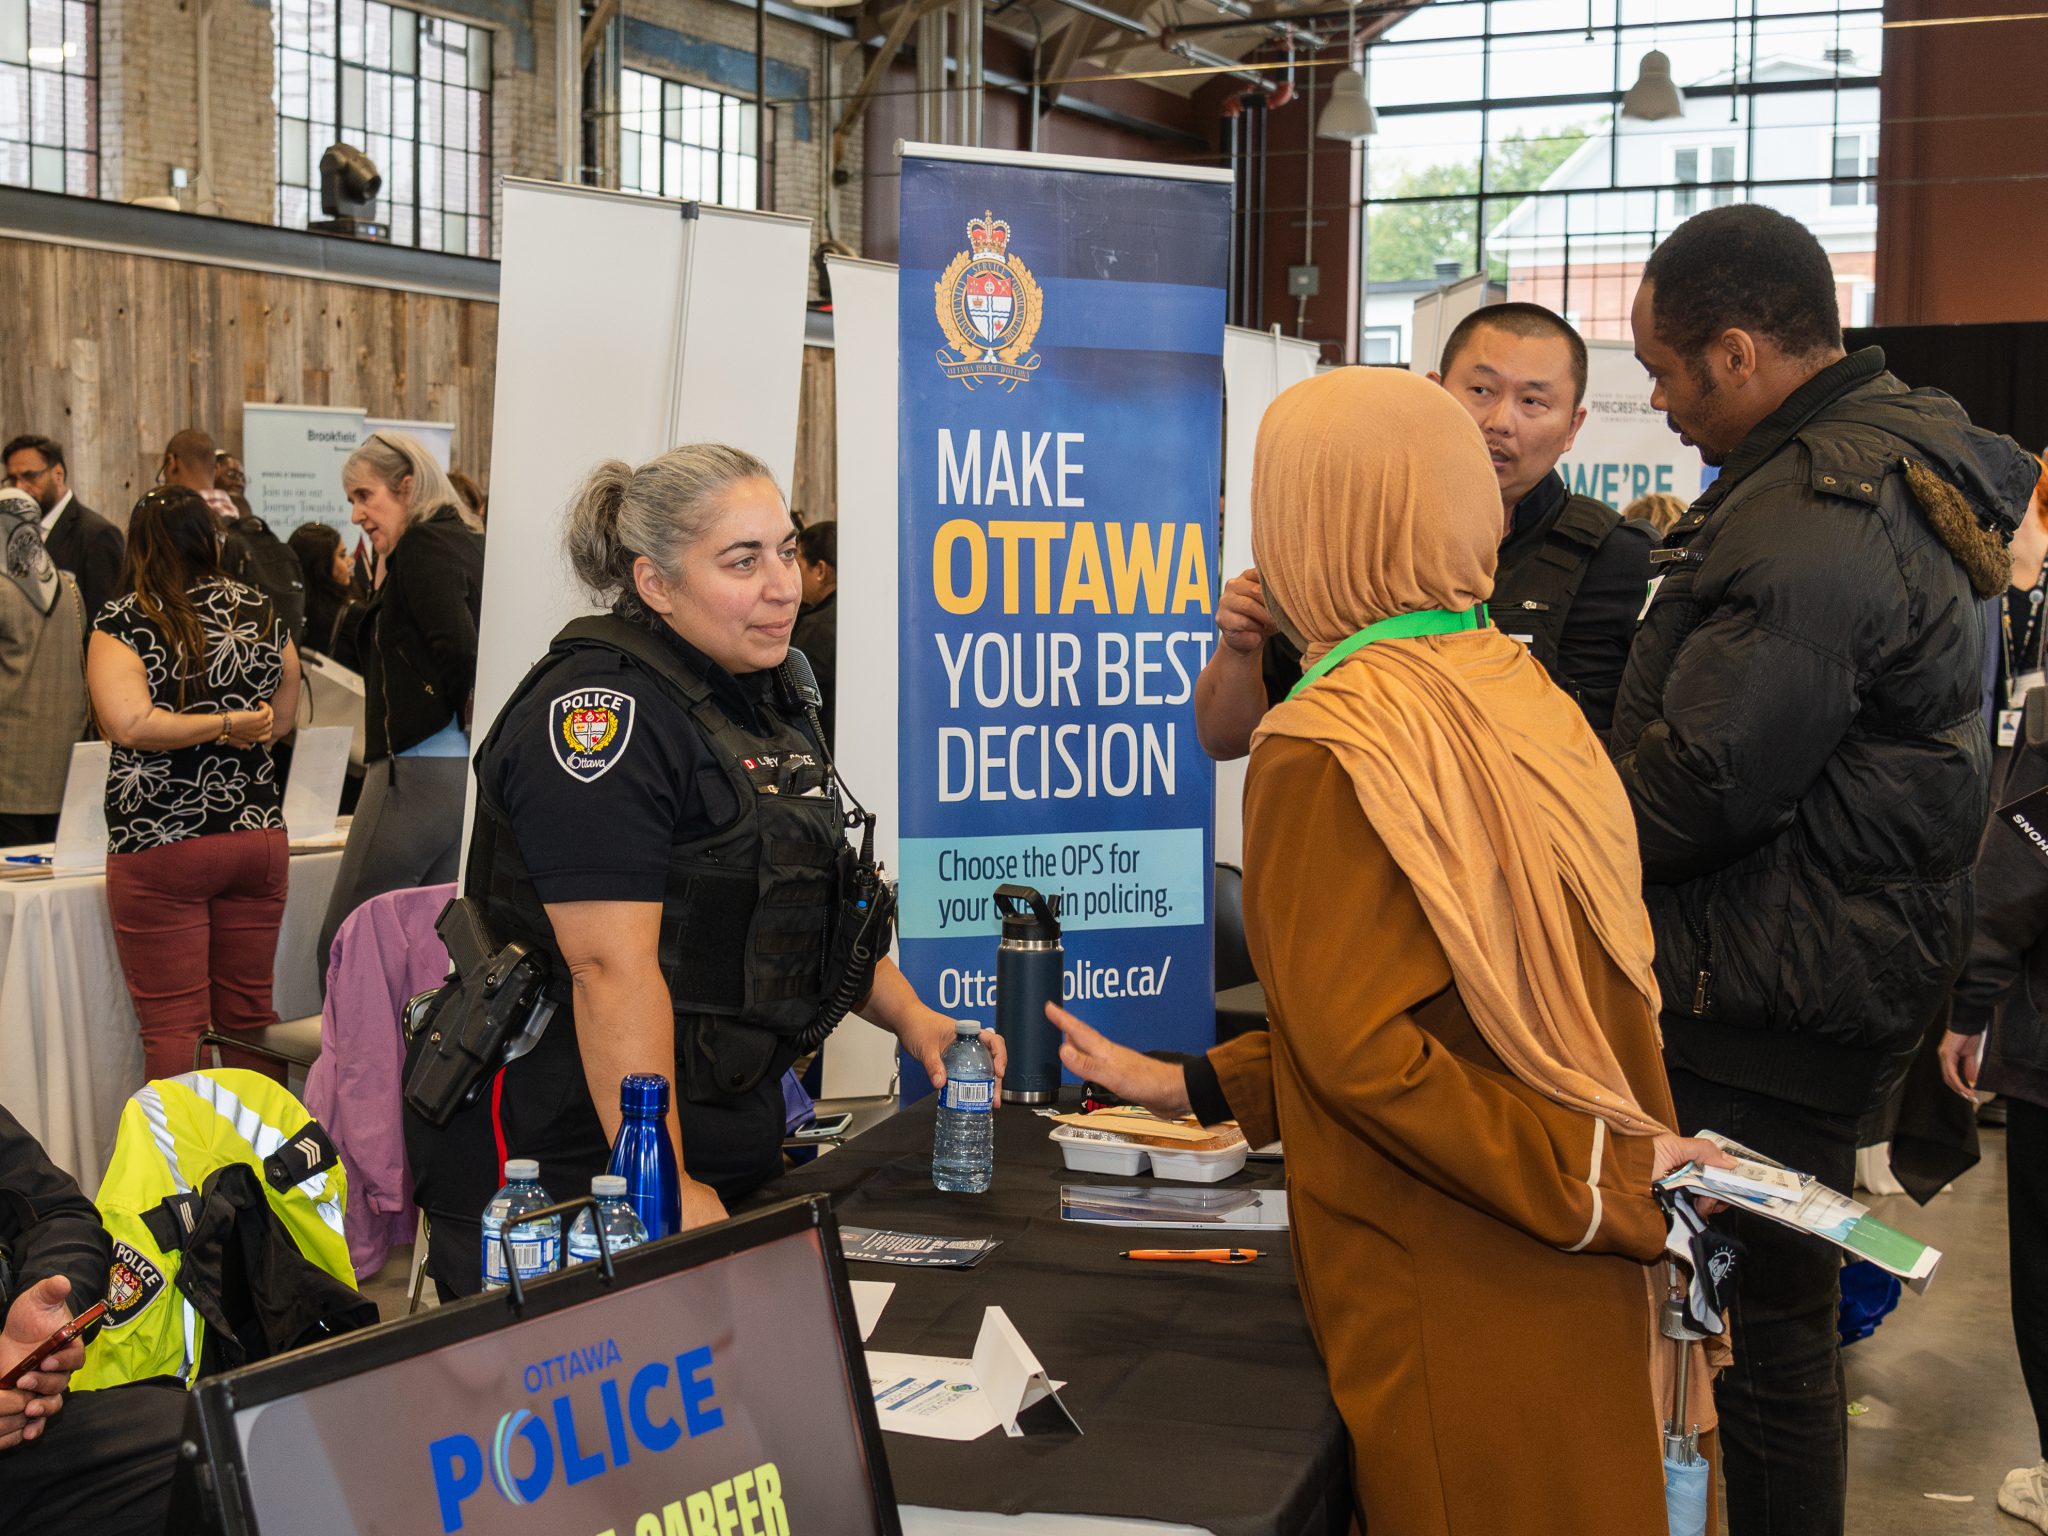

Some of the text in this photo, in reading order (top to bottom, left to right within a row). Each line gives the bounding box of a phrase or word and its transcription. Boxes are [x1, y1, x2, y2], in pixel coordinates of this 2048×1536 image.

[947, 365, 974, 375] OTTAWA
[976, 364, 997, 373] POLICE
[937, 428, 1085, 508] MAKE
[1561, 463, 1674, 511] WE'RE
[933, 519, 1211, 614] OTTAWA
[935, 631, 1213, 708] YOUR BEST
[561, 692, 624, 713] POLICE
[567, 751, 606, 769] Ottawa
[938, 722, 1176, 802] DECISION
[938, 843, 1140, 881] Choose the OPS for
[938, 897, 989, 929] your
[1061, 886, 1079, 917] in
[1084, 882, 1173, 921] policing.
[939, 956, 1172, 1009] Ottaolice.ca/
[116, 1244, 160, 1287] POLICE
[523, 1338, 623, 1394] OTTAWA
[429, 1345, 725, 1534] POLICE
